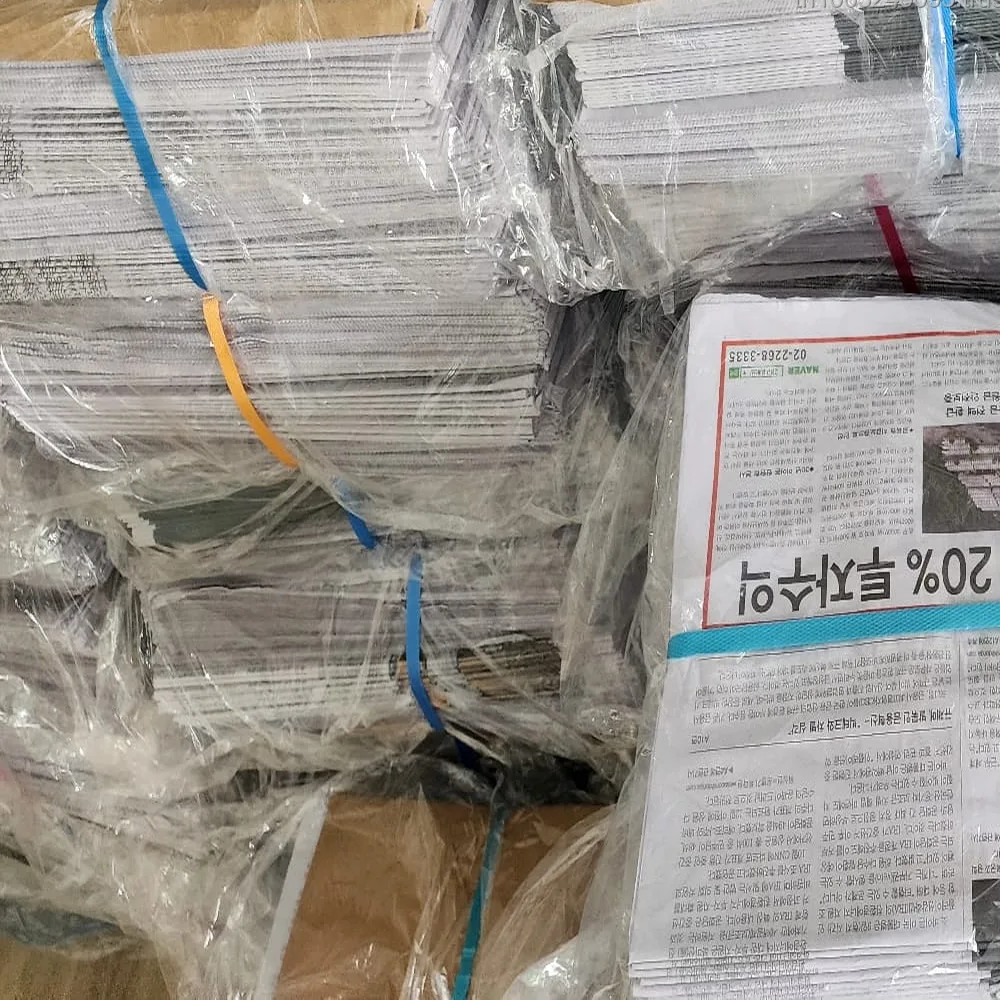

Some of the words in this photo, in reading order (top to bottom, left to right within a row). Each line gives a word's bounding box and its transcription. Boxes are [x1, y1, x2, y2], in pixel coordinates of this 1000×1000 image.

[729, 349, 806, 362] 02-2268-3335
[788, 365, 819, 375] NAVER
[983, 391, 1000, 401] 원금
[946, 406, 963, 417] 환급
[967, 405, 985, 416] 전액
[906, 545, 992, 596] 20%
[738, 546, 896, 616] 투자수익
[903, 709, 927, 726] 발묶인
[809, 719, 824, 734] 차별
